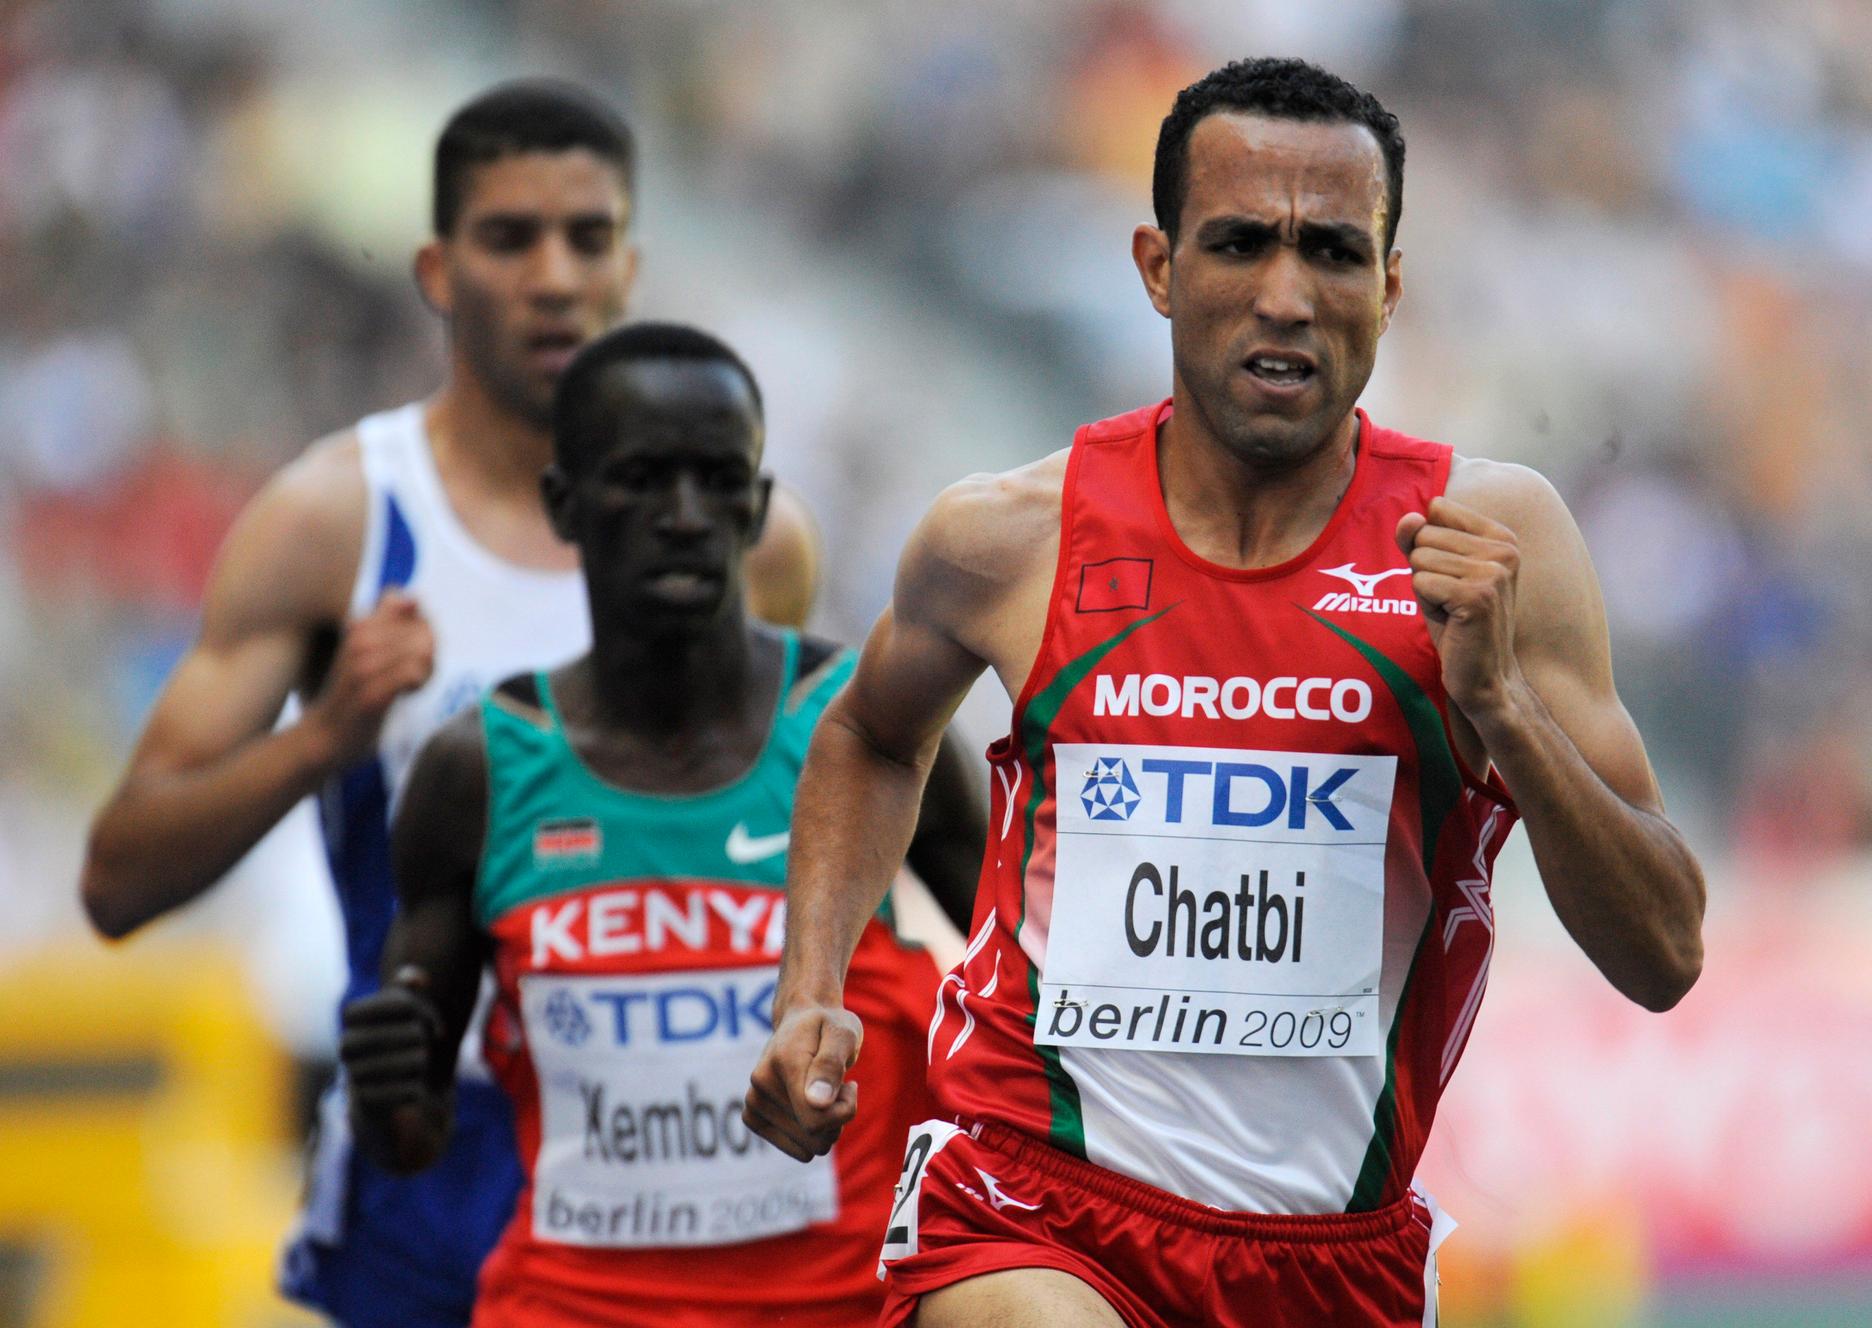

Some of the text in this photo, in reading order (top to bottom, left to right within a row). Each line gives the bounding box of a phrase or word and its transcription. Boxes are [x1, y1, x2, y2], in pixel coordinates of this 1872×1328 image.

[1312, 593, 1418, 616] MIZUNO
[1093, 673, 1373, 723] MOROCCO
[1142, 758, 1360, 831] TDK
[1124, 861, 1305, 963] Chatbi
[1048, 990, 1228, 1045] berlin
[1239, 1009, 1353, 1049] 2009
[580, 1075, 766, 1163] Kembo
[548, 1191, 698, 1234] berlin
